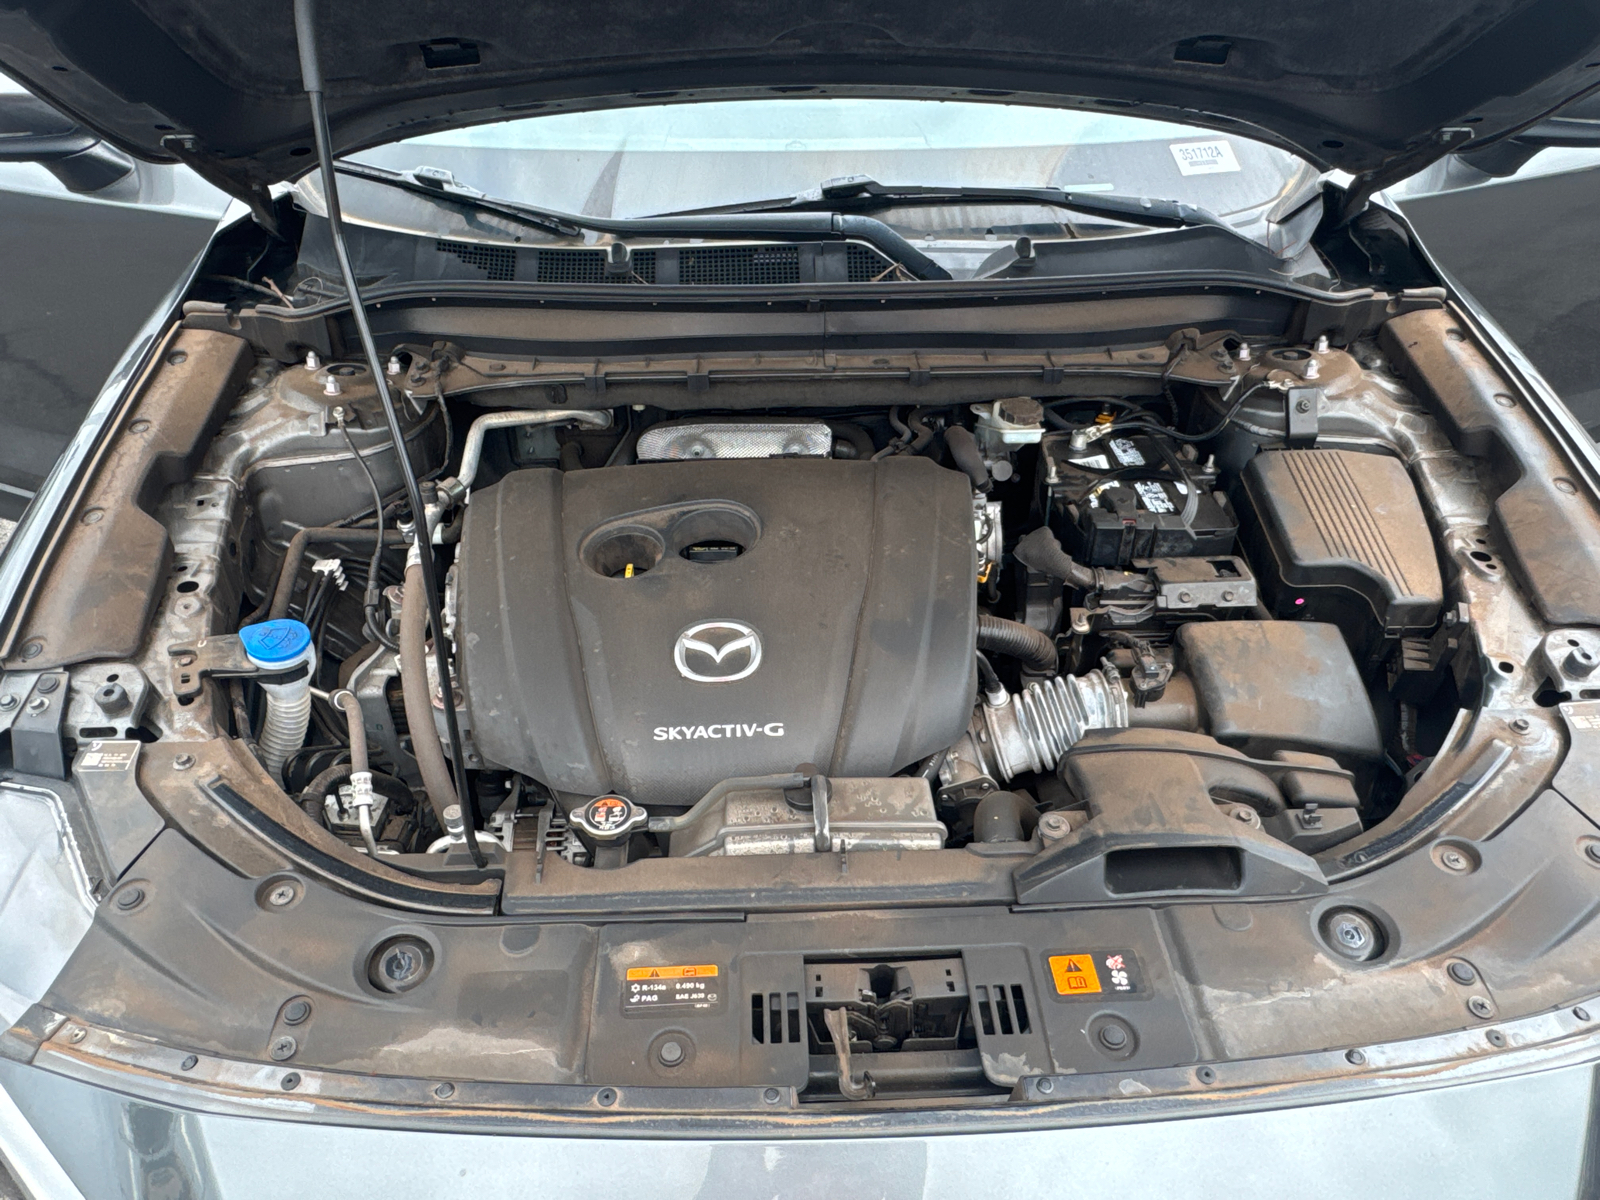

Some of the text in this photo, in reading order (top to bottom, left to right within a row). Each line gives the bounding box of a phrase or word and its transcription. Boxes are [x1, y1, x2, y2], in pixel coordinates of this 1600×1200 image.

[1179, 146, 1224, 161] 351712A
[653, 722, 785, 741] SKYACTIV-G
[641, 983, 667, 992] R-134a
[641, 994, 658, 1002] PAG
